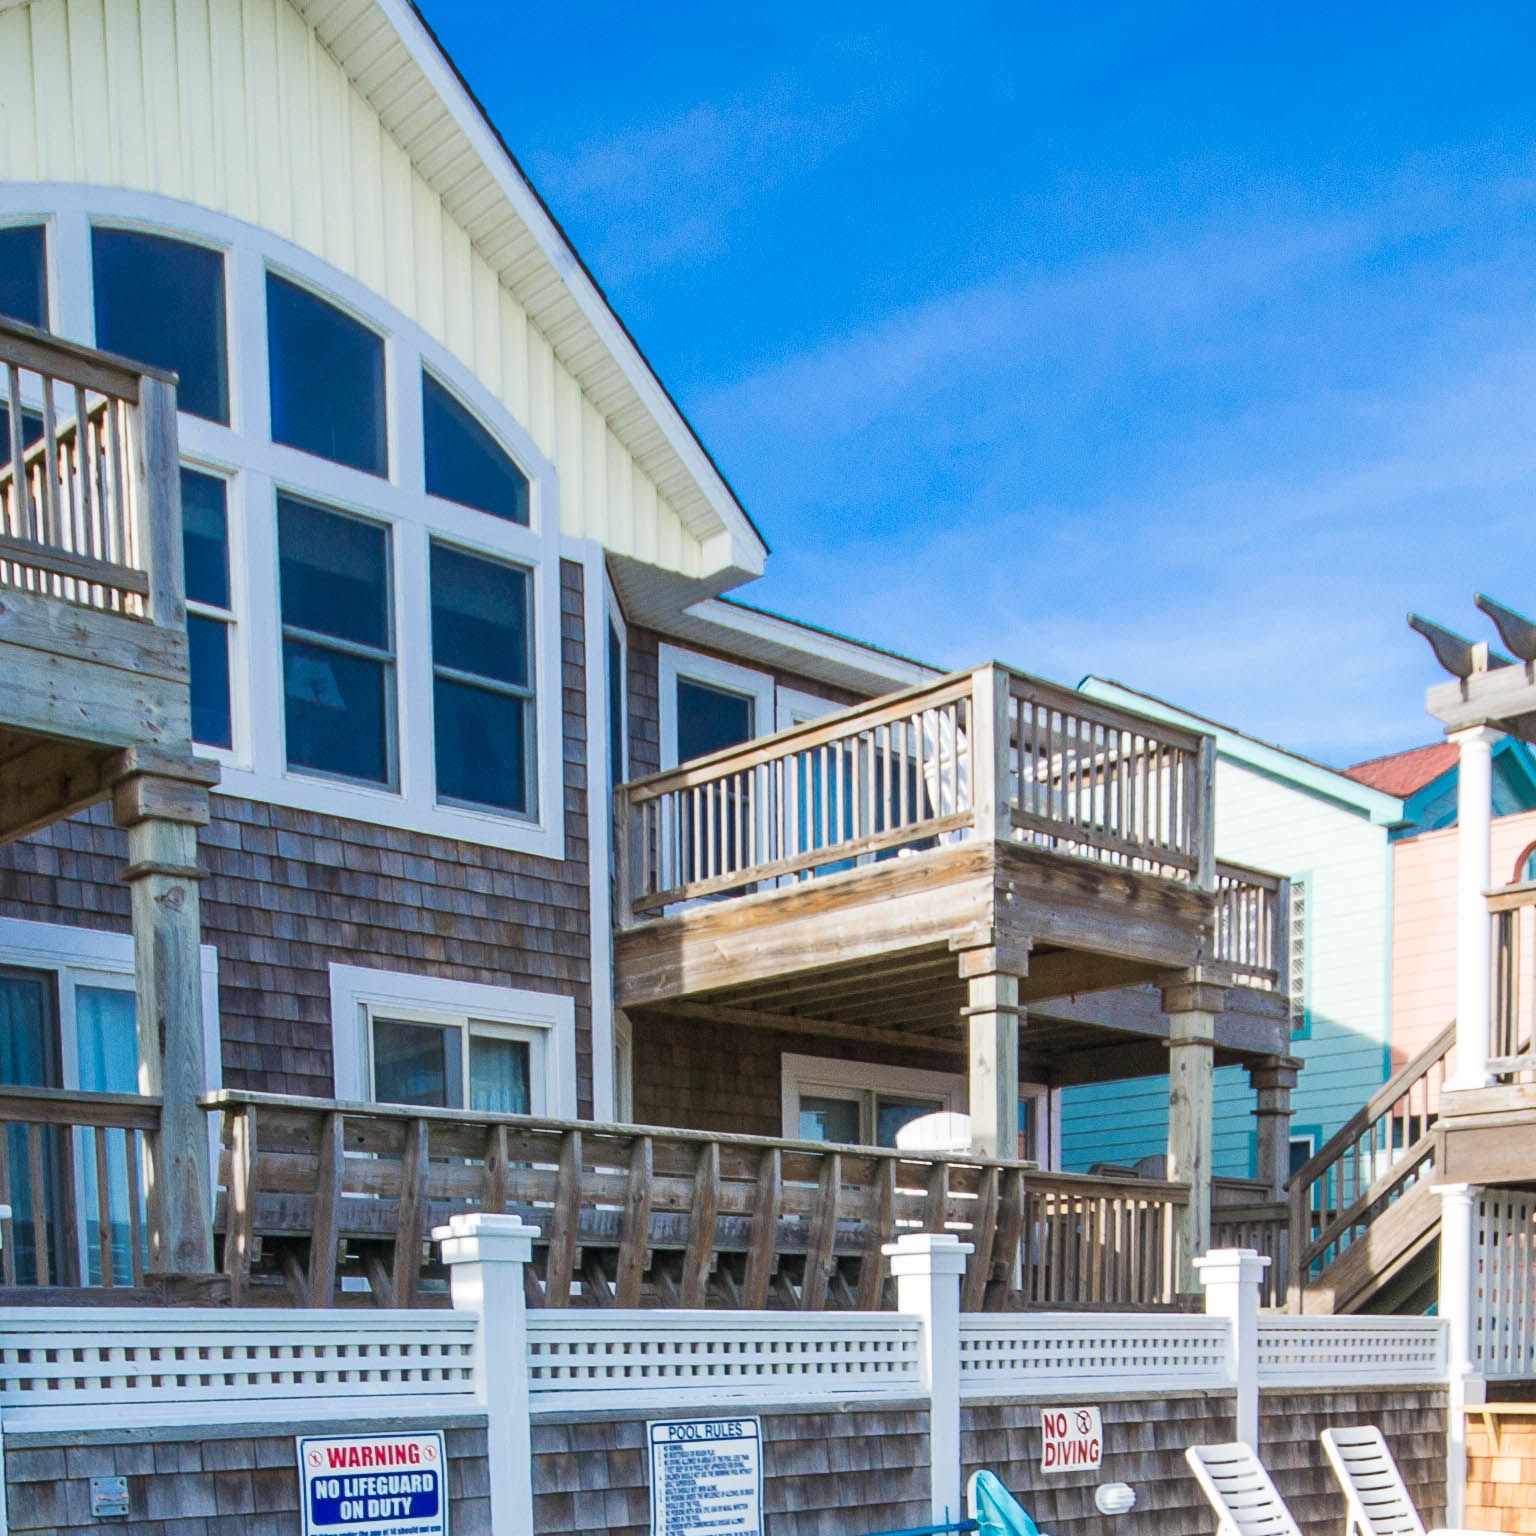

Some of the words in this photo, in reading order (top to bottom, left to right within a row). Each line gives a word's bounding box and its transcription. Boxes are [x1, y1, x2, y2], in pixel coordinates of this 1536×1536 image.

[668, 1425, 701, 1439] POOL
[705, 1423, 743, 1437] RULES
[1044, 1412, 1067, 1438] NO
[327, 1443, 420, 1468] WARNING
[1044, 1439, 1099, 1466] DIVING
[315, 1479, 340, 1500] NO
[344, 1473, 433, 1498] LIFEGUARD
[340, 1500, 364, 1521] ON
[368, 1497, 412, 1518] DUTY
